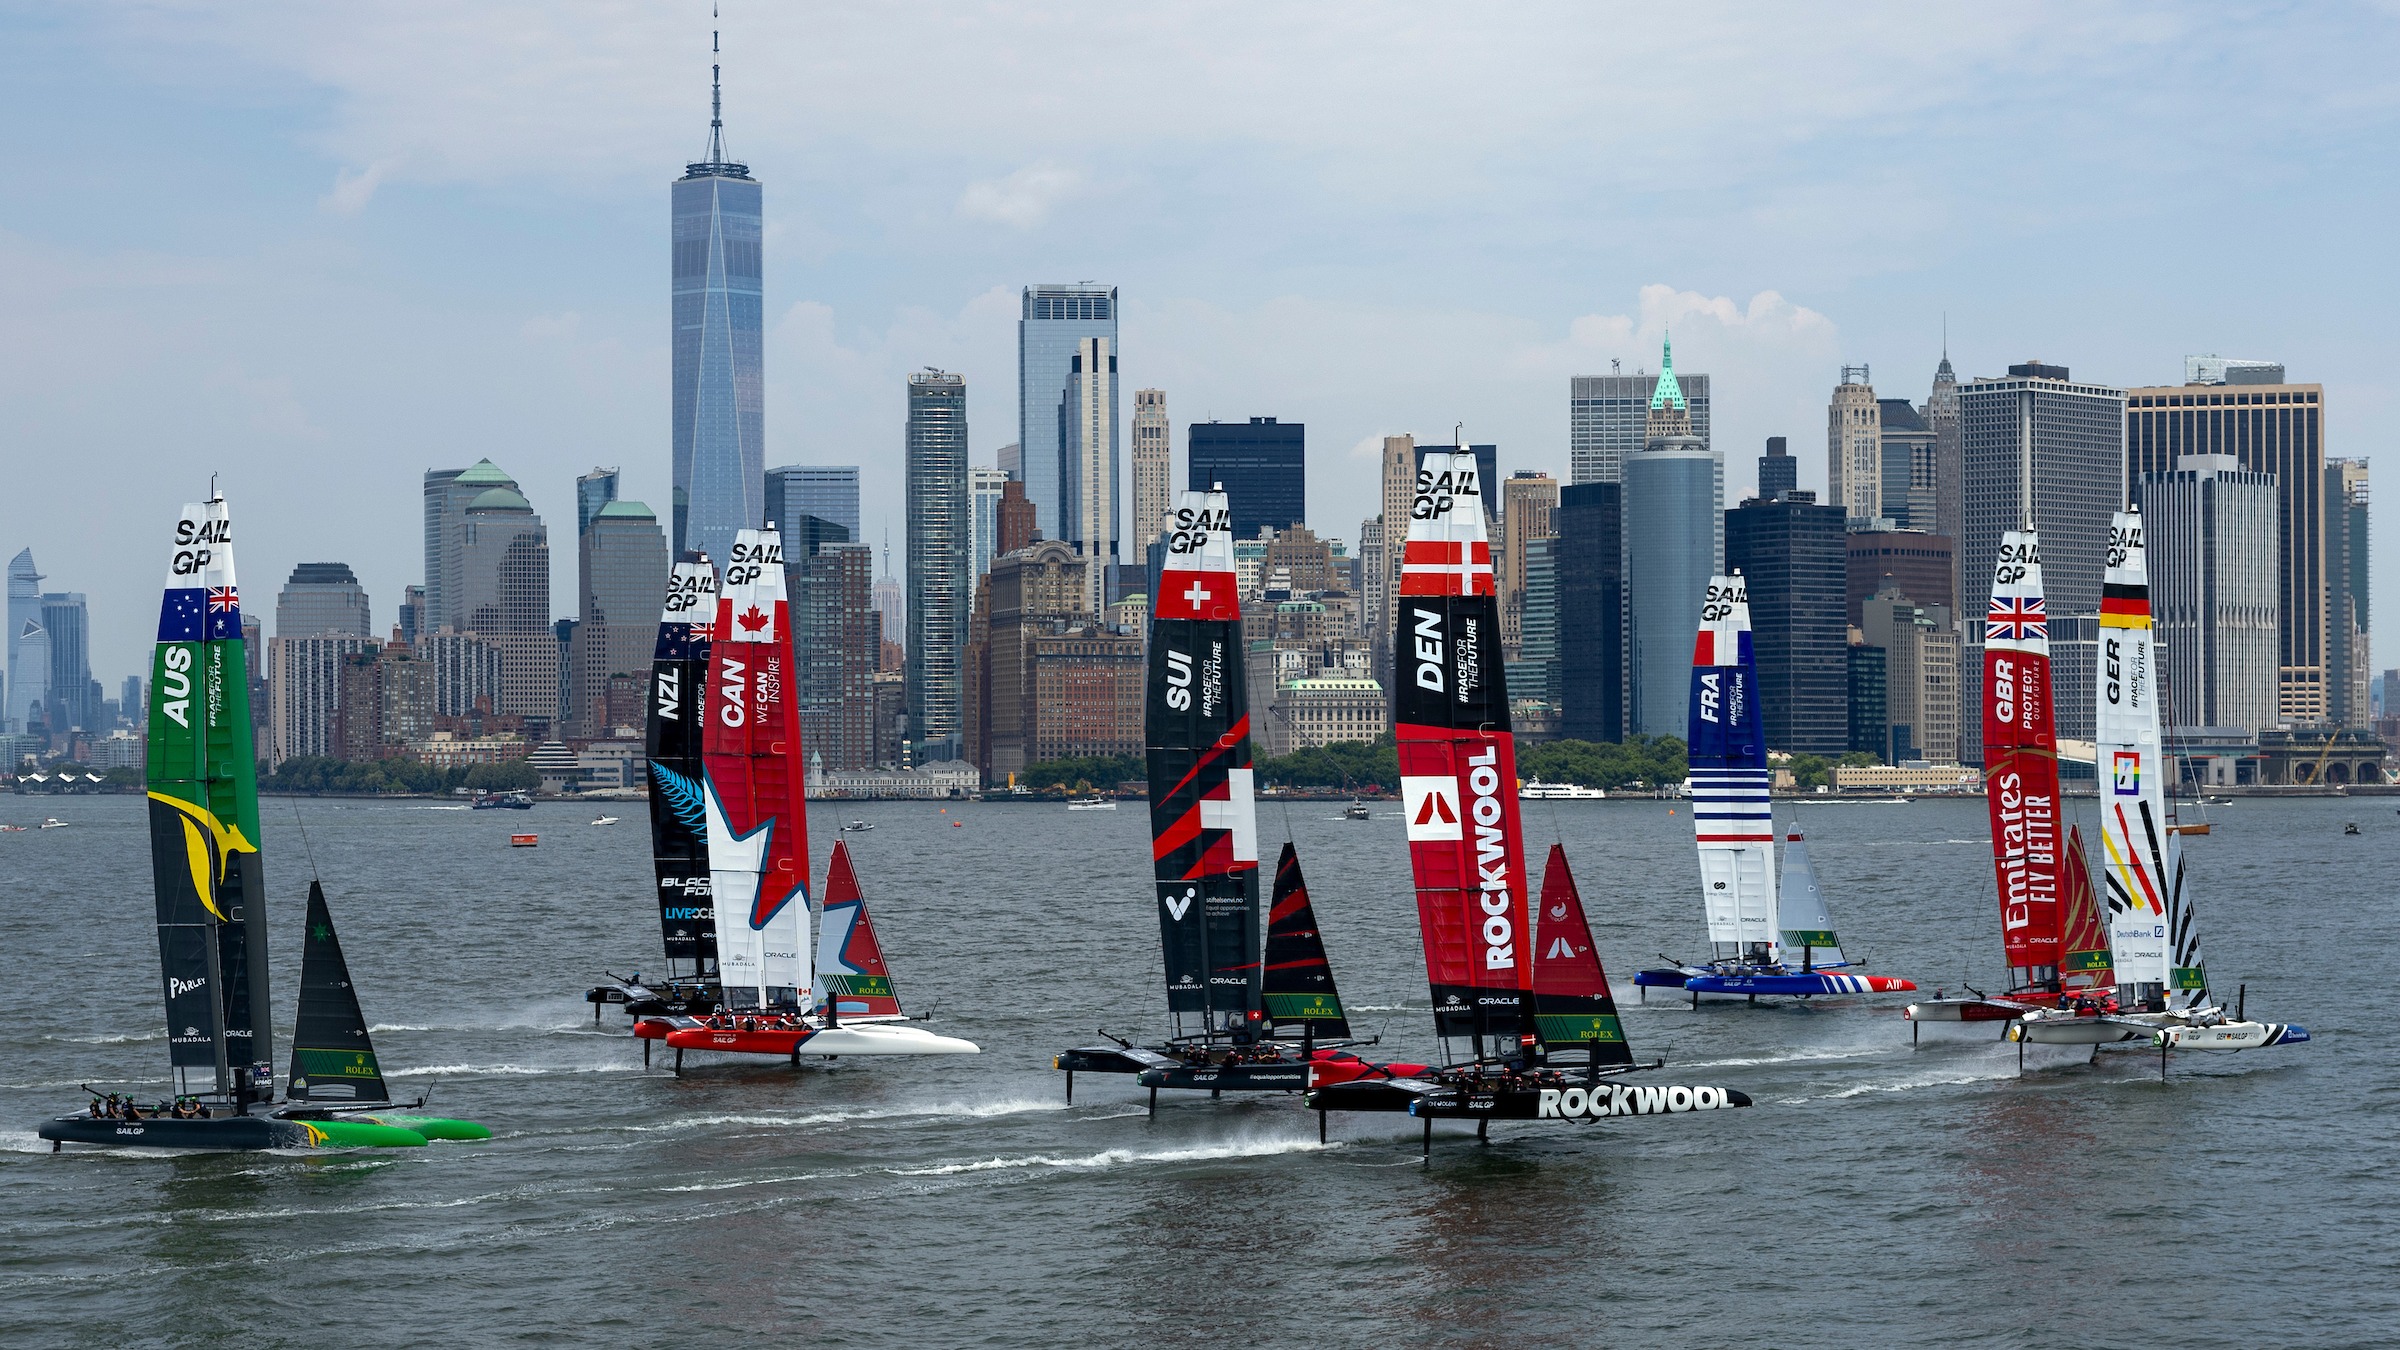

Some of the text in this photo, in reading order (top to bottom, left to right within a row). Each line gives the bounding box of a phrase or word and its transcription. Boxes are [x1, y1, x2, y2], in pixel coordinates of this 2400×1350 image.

[1416, 470, 1479, 496] SAIL
[1410, 495, 1454, 520] GP
[1174, 508, 1231, 532] SAIL
[174, 520, 232, 546] SAIL
[1169, 532, 1208, 554] GP
[2108, 526, 2144, 548] SAIL
[172, 549, 211, 575] GP
[730, 544, 784, 564] SAIL
[2000, 544, 2040, 564] SAIL
[2106, 548, 2127, 568] GP
[668, 575, 715, 593] SAIL
[726, 566, 761, 586] GP
[1996, 566, 2026, 585] GP
[665, 594, 697, 612] GP
[1706, 585, 1748, 603] SAIL
[1701, 604, 1732, 621] GP
[1414, 608, 1445, 693] DEN
[768, 656, 780, 703] INSPIRE
[1166, 649, 1193, 711] SUI
[2107, 638, 2120, 705] GER
[163, 646, 191, 729] AUS
[658, 667, 679, 720] NZL
[721, 657, 745, 728] CAN
[1701, 673, 1719, 723] FRA
[1995, 659, 2014, 723] GBR
[2023, 667, 2033, 730] PROTECT
[1468, 745, 1515, 970] ROCKWOOL
[1999, 772, 2028, 932] Emirates
[2025, 795, 2056, 903] FLY BETTER
[661, 877, 711, 887] BLAC
[170, 977, 206, 999] PARLEY
[858, 987, 887, 995] ROLEX
[1210, 977, 1247, 985] ORACLE
[1435, 1004, 1471, 1013] MUBADALA
[1478, 997, 1520, 1005] ORACLE
[1580, 1030, 1613, 1039] ROLEX
[345, 1066, 374, 1075] ROLEX
[1538, 1084, 1734, 1118] ROCKWOOL
